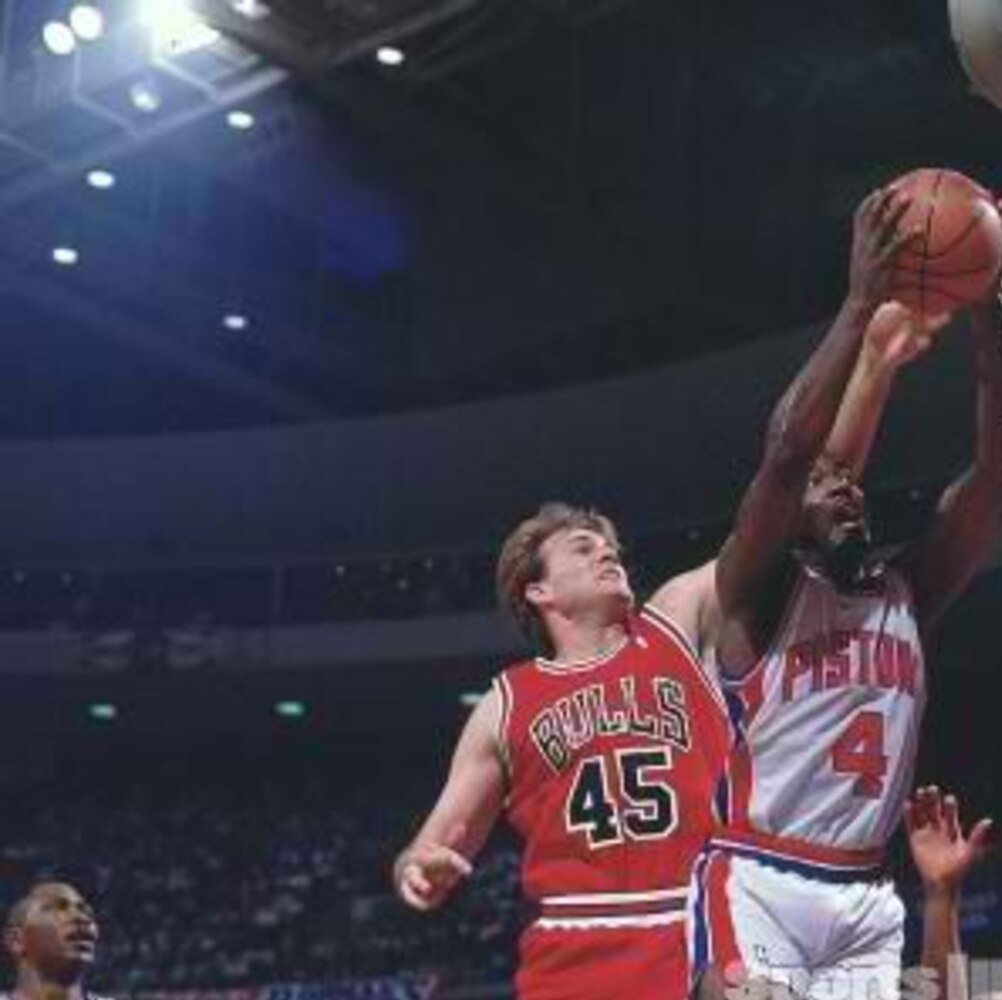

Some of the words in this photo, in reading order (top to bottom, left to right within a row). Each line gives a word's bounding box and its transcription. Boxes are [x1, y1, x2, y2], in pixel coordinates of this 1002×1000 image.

[529, 675, 692, 775] BULLS
[833, 711, 888, 798] 4
[565, 745, 678, 850] 45
